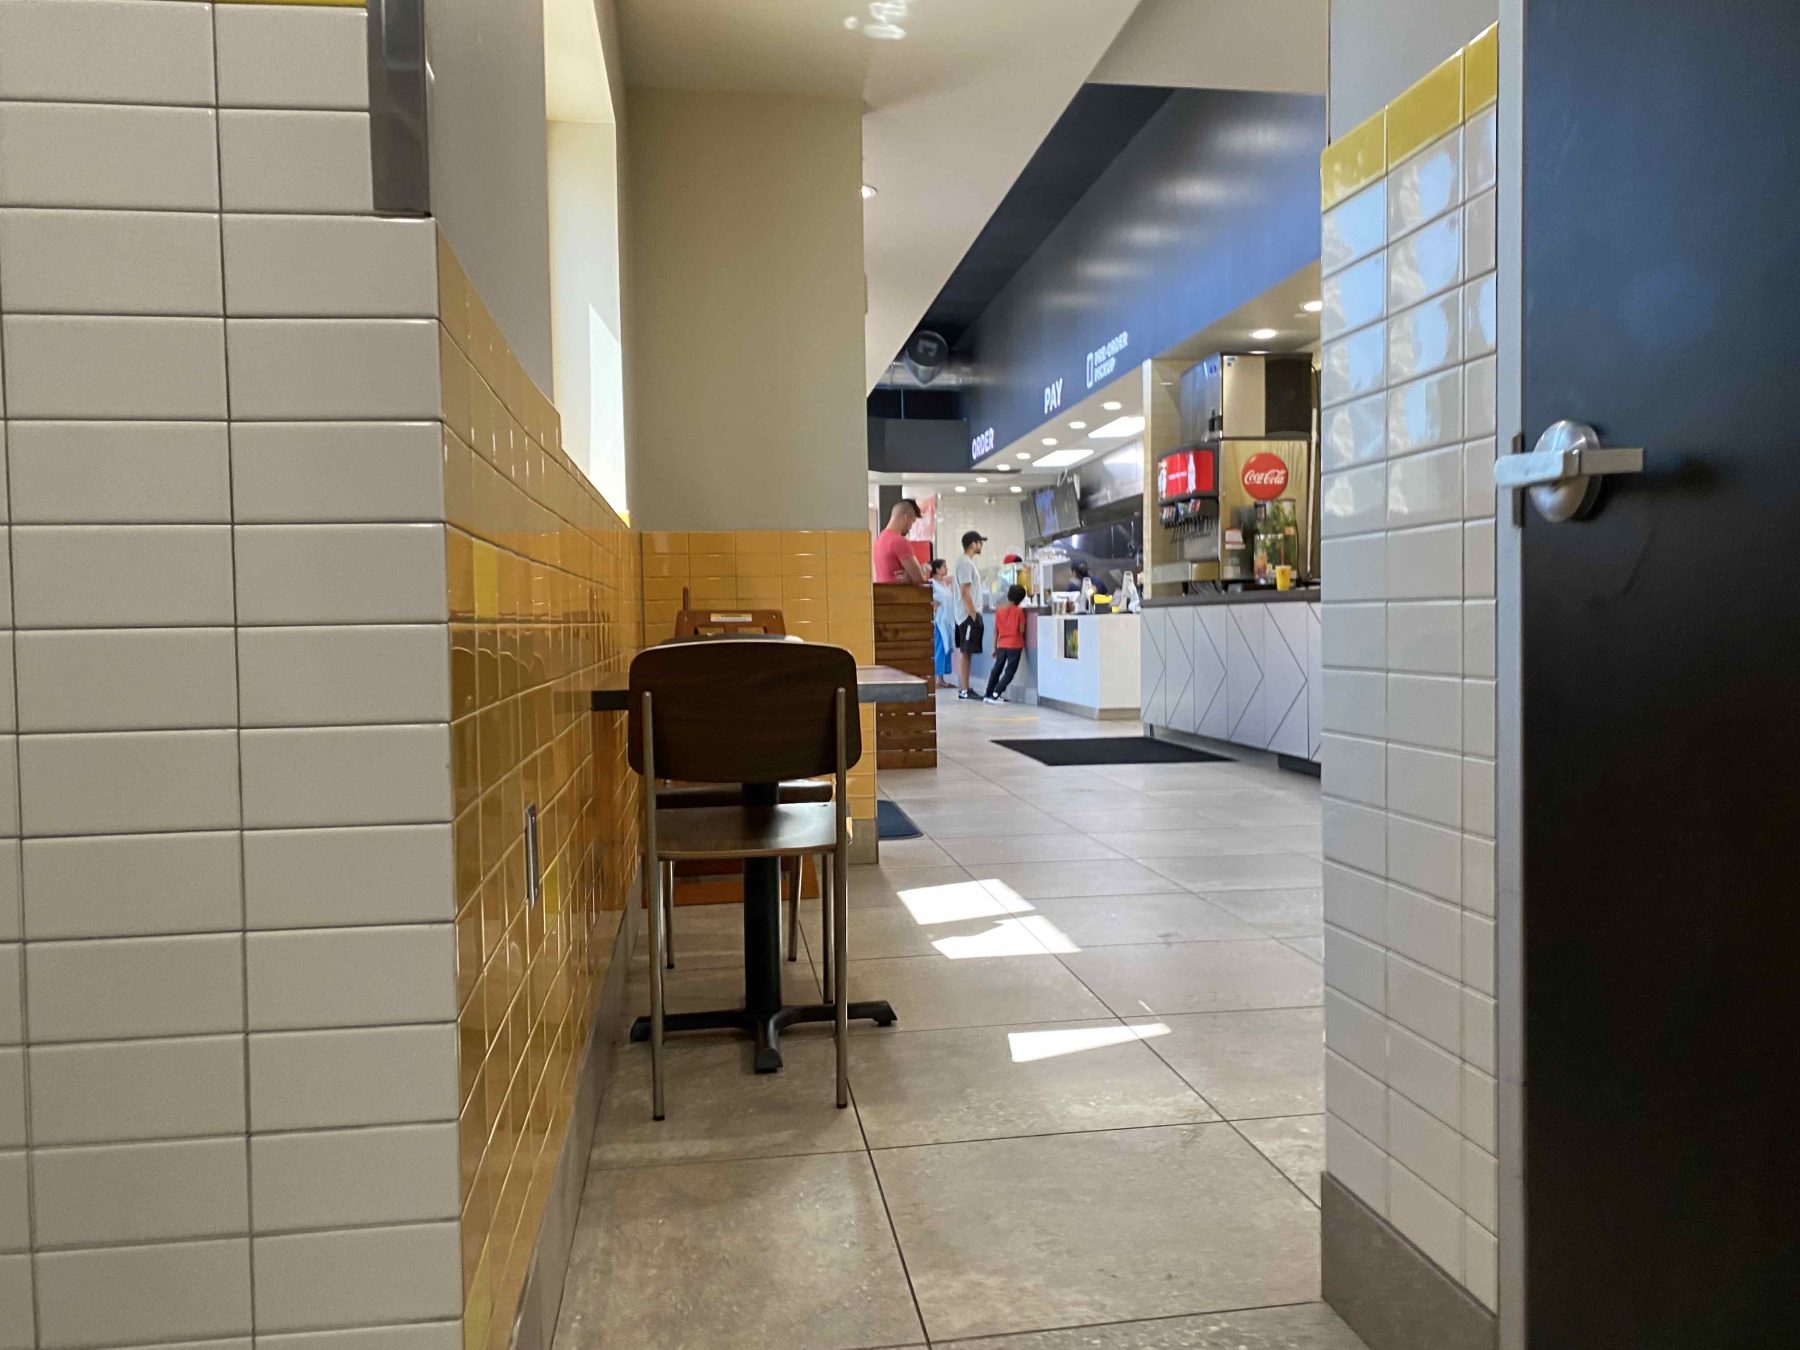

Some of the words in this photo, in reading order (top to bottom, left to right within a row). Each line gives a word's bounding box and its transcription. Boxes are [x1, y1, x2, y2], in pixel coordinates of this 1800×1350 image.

[1094, 331, 1128, 366] PRE-ORDER
[1094, 357, 1116, 382] PICKUP
[1044, 377, 1063, 415] PAY
[971, 427, 994, 460] ORDER
